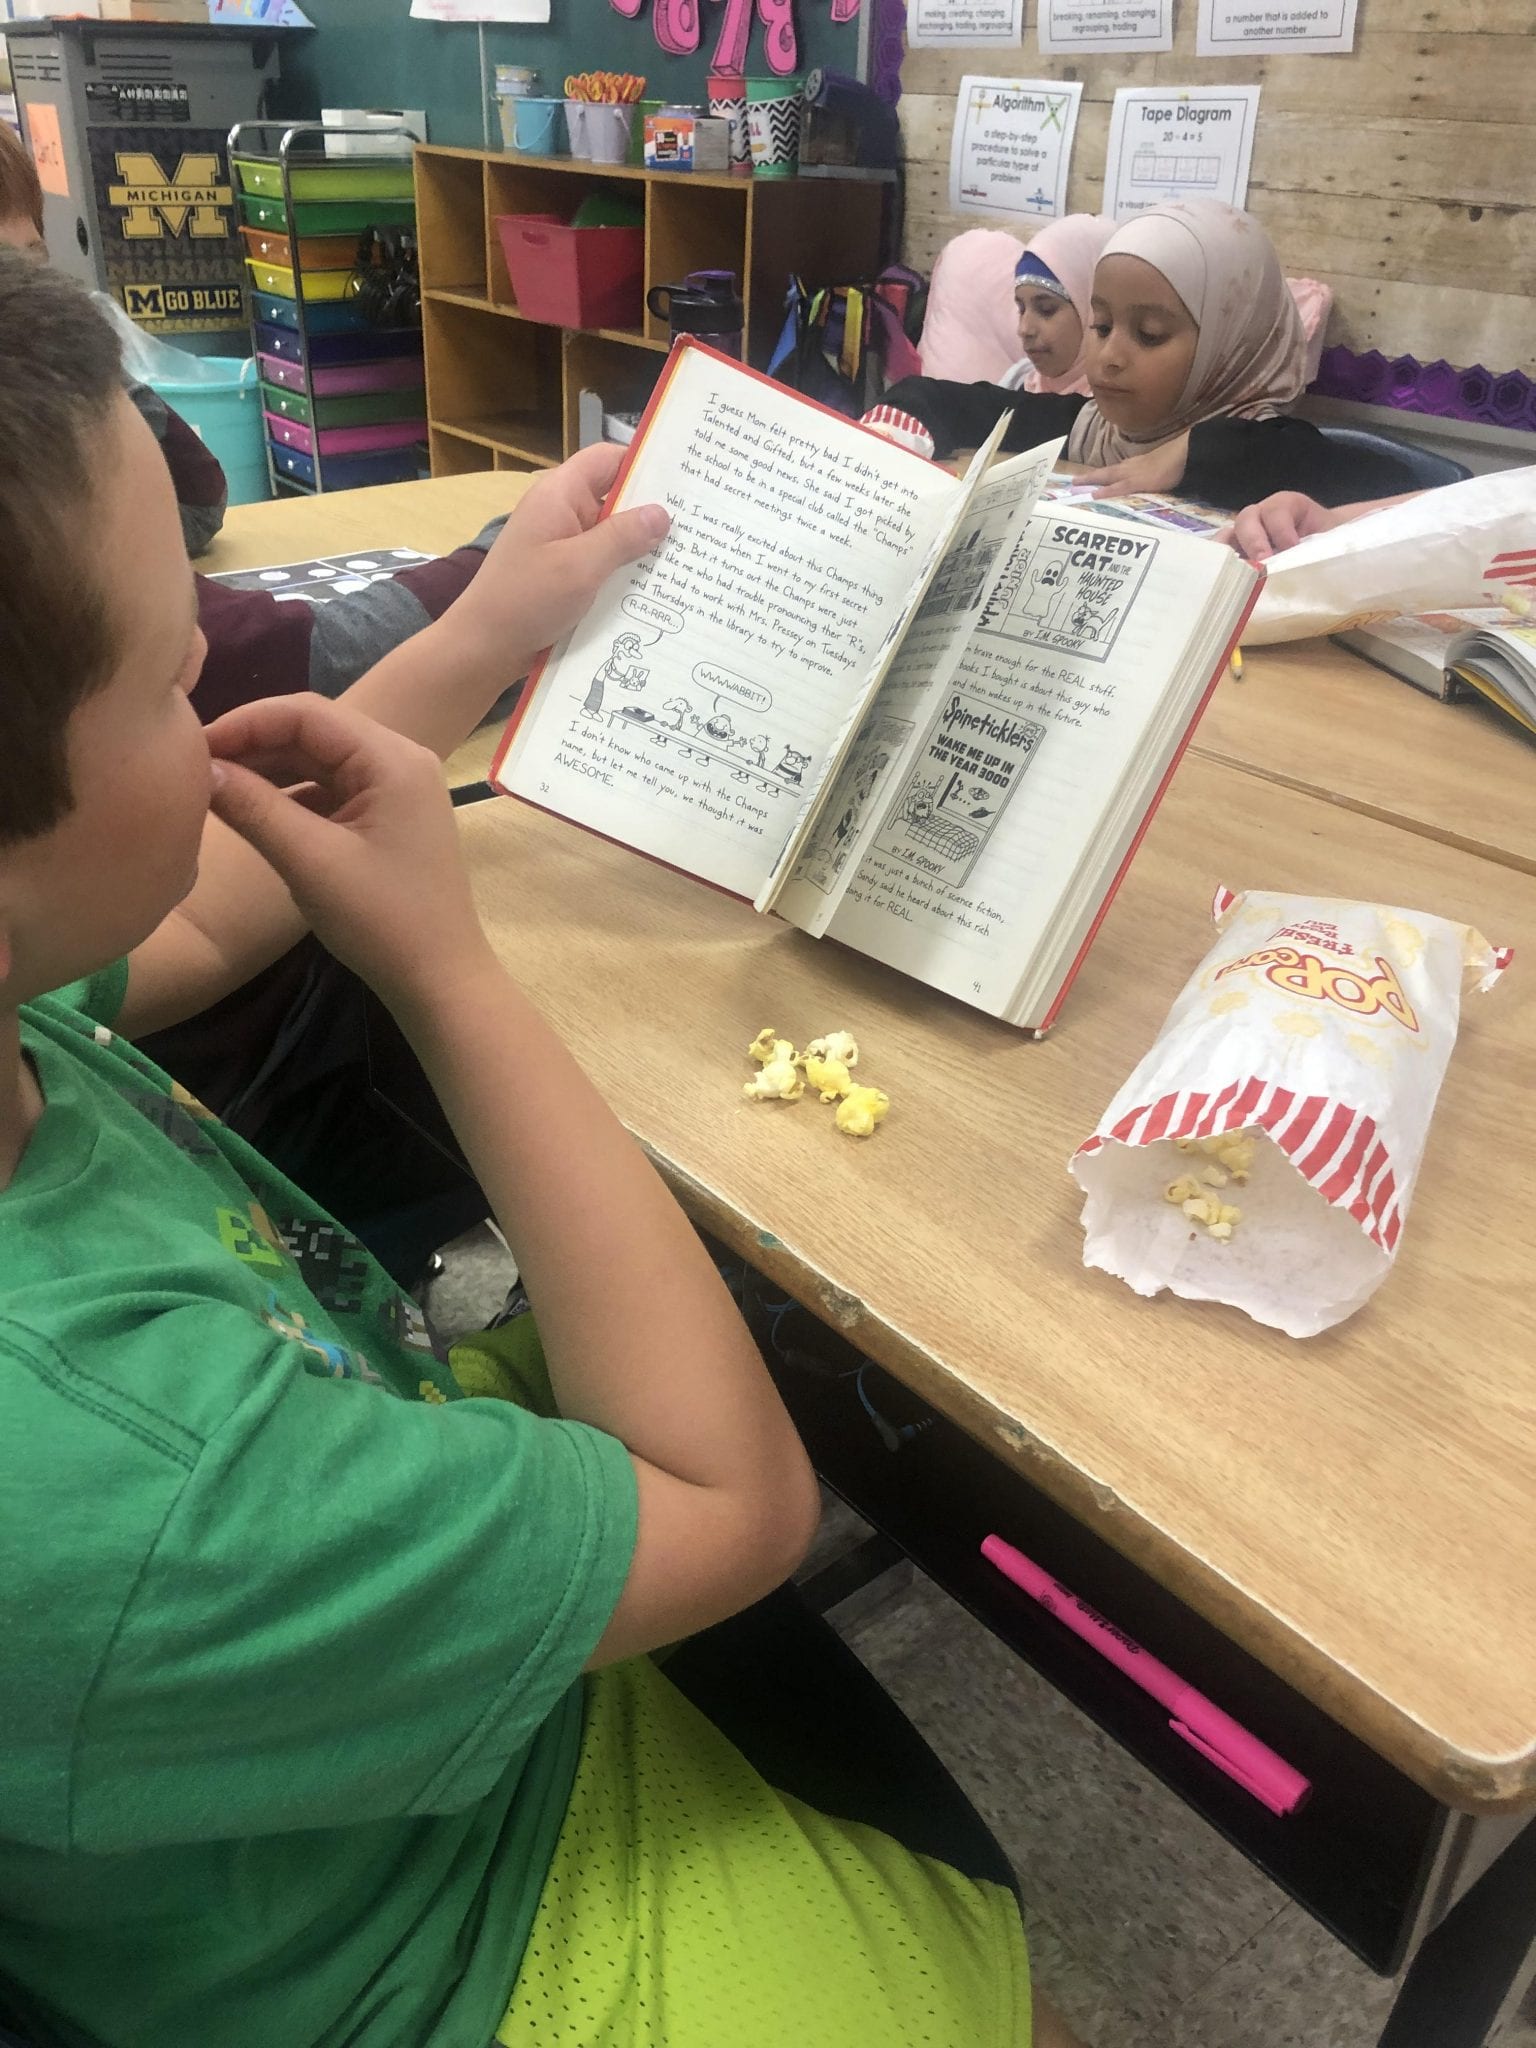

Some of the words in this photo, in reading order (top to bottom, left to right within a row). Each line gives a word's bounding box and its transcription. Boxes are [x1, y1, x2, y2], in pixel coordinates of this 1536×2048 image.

[1233, 13, 1263, 23] number
[1265, 12, 1280, 21] that
[1290, 10, 1318, 21] added
[1320, 10, 1328, 19] to
[1243, 26, 1273, 36] another
[1275, 25, 1307, 34] number
[992, 95, 1045, 112] Algorithm
[1141, 106, 1173, 124] Tape
[1176, 106, 1232, 124] Diagram
[971, 142, 1009, 155] procedure
[1020, 146, 1039, 157] solve
[1012, 160, 1029, 171] type
[990, 172, 1021, 184] problem
[127, 190, 218, 202] MICHIGAN
[128, 289, 161, 313] M
[166, 292, 190, 310] GO
[193, 290, 240, 309] BLUE
[702, 409, 741, 437] Talented
[844, 480, 870, 497] weeks
[872, 489, 895, 507] later
[717, 403, 744, 418] guess
[769, 422, 786, 438] felt
[788, 435, 820, 458] pretty
[853, 461, 880, 481] didn't
[900, 487, 918, 500] into
[680, 459, 701, 477] that
[723, 483, 751, 501] secret
[753, 498, 792, 522] meetings
[796, 514, 817, 531] twice
[694, 427, 713, 443] told
[728, 446, 749, 461] some
[749, 458, 774, 472] good
[822, 490, 842, 503] said
[874, 515, 903, 533] picked
[704, 453, 731, 471] school
[777, 489, 806, 506] special
[807, 500, 823, 514] club
[825, 511, 851, 527] called
[1052, 525, 1149, 559] SCAREDY
[695, 529, 727, 549] nervous
[729, 543, 751, 560] when
[766, 562, 788, 576] went
[819, 582, 839, 599] first
[841, 596, 867, 613] secret
[720, 521, 745, 542] really
[746, 534, 778, 552] excited
[778, 545, 803, 563] about
[806, 557, 823, 573] this
[825, 566, 858, 591] Champs
[861, 583, 883, 606] thing
[1070, 549, 1113, 572] CAT
[664, 551, 679, 566] like
[735, 585, 764, 605] trouble
[766, 601, 817, 633] pronouncing
[821, 623, 842, 639] their
[720, 558, 744, 576] turns
[782, 585, 815, 610] Champs
[817, 605, 836, 619] were
[835, 616, 857, 628] just
[1075, 587, 1113, 606] HOUSE
[1077, 571, 1124, 592] HAUNTED
[650, 586, 693, 616] Thursdays
[725, 617, 755, 643] library
[702, 591, 724, 606] work
[726, 602, 745, 616] with
[771, 618, 804, 647] Pressey
[821, 642, 856, 670] Tuesdays
[973, 643, 993, 659] brave
[994, 654, 1022, 670] enough
[1052, 633, 1085, 650] SPOOKY
[958, 657, 979, 673] books
[990, 667, 1019, 687] bought
[1028, 681, 1053, 696] about
[987, 688, 1011, 703] wakes
[943, 696, 1035, 753] Spineticklers
[929, 745, 949, 762] THE
[950, 754, 979, 775] YEAR
[978, 767, 1010, 789] 3000
[937, 733, 967, 755] WAKE
[966, 747, 984, 761] ME
[983, 753, 1000, 768] UP
[1000, 760, 1015, 775] IN
[539, 781, 549, 793] 32
[580, 725, 605, 744] don't
[607, 736, 631, 756] know
[654, 762, 674, 776] came
[692, 779, 711, 793] with
[734, 794, 768, 820] Champs
[641, 773, 657, 786] tell
[697, 797, 734, 821] thought
[916, 855, 946, 875] SPOOKY
[1214, 947, 1301, 981] corn
[973, 981, 982, 993] 41
[1265, 954, 1419, 1032] POP
